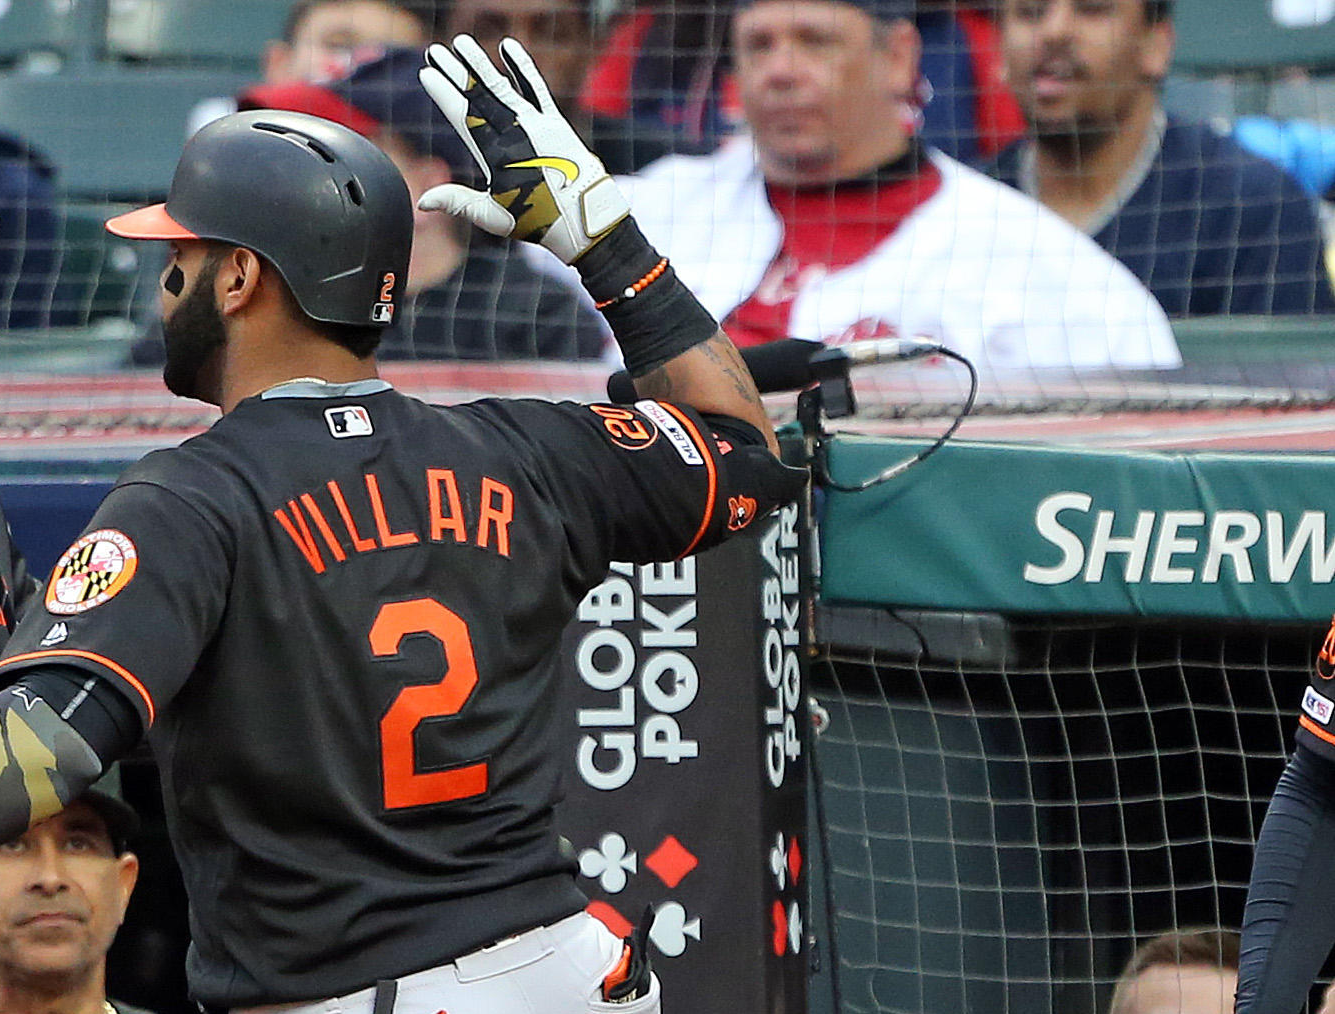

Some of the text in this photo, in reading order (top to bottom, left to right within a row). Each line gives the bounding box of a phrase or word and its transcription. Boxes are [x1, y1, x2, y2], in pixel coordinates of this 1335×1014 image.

[380, 272, 395, 301] 2
[273, 468, 514, 574] VILLAR
[368, 597, 488, 809] 2
[577, 561, 636, 791] GLOB
[640, 556, 700, 764] POKE
[761, 510, 785, 788] GLOBA
[780, 502, 801, 761] POKER
